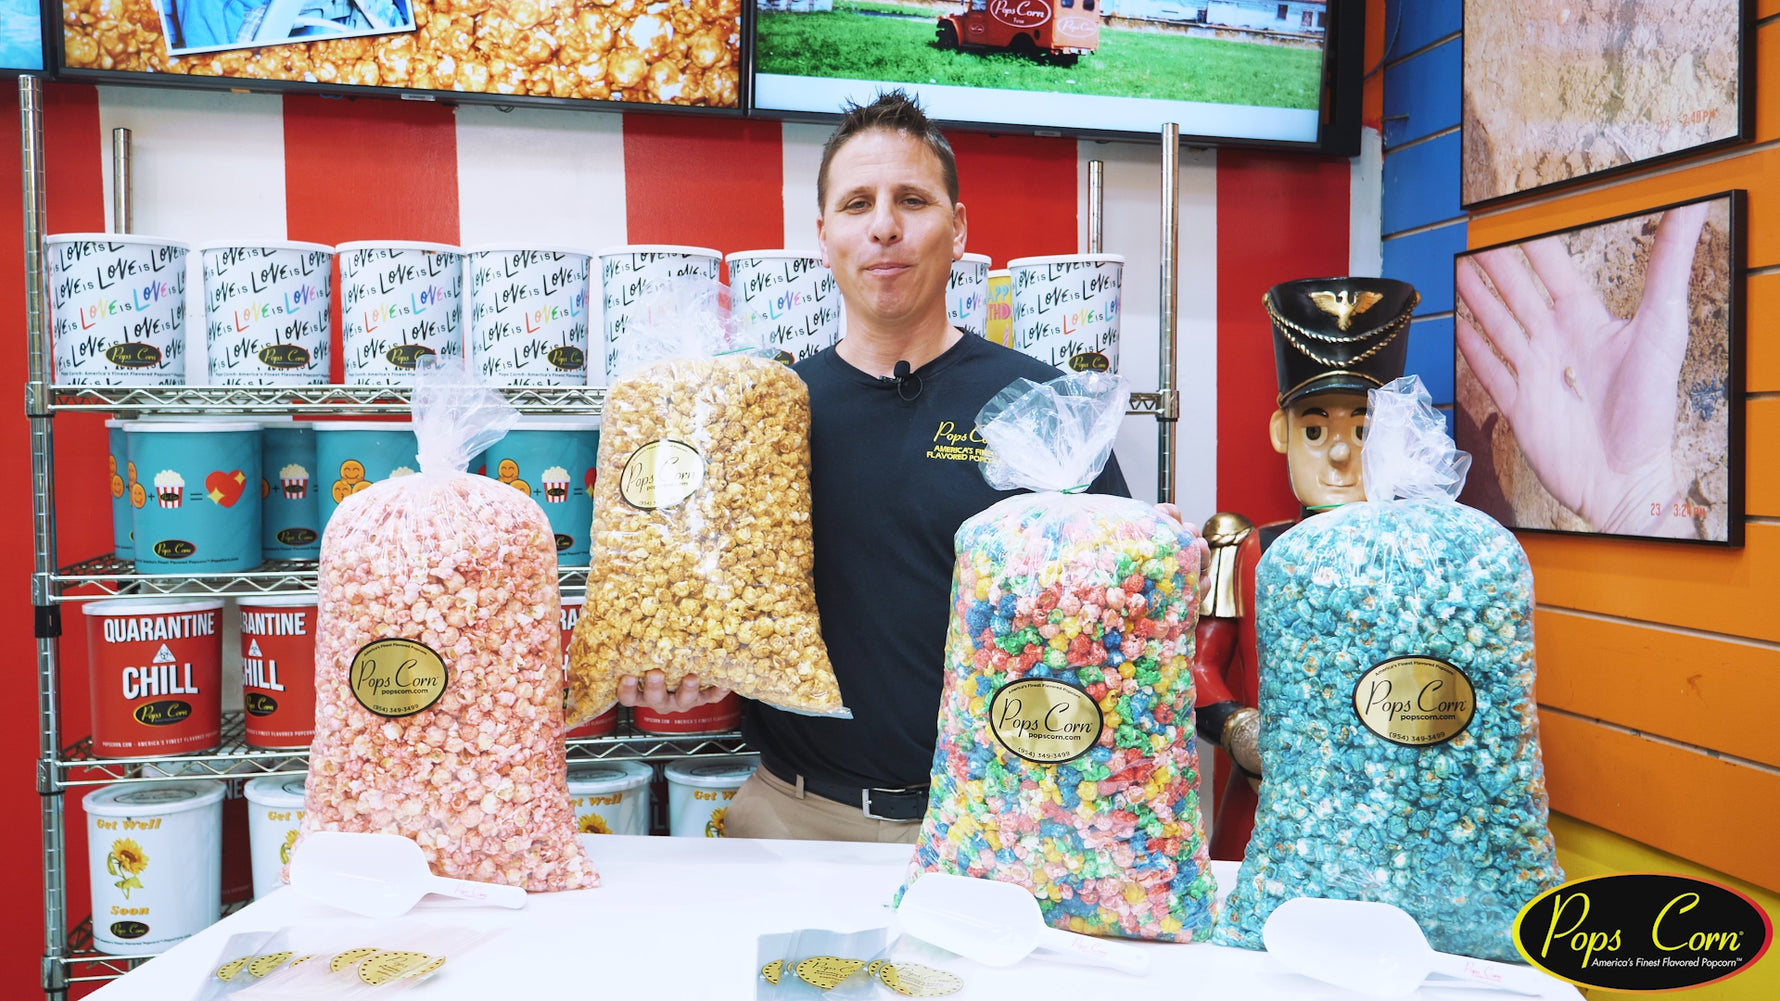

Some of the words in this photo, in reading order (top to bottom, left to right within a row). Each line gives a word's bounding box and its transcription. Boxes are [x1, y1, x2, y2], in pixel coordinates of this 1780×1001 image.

[994, 0, 1016, 17] Pops
[1016, 0, 1045, 18] Corn
[60, 241, 91, 272] LOVE
[216, 247, 246, 276] LOVE
[348, 249, 374, 278] LOVE
[505, 250, 538, 278] LOVE
[55, 277, 81, 309] LOVE
[97, 258, 137, 290] LOVE
[151, 245, 179, 272] LOVE
[210, 281, 235, 312] LOVE
[251, 262, 288, 293] LOVE
[301, 251, 326, 277] LOVE
[344, 283, 365, 314] LOVE
[379, 264, 414, 294] LOVE
[428, 252, 455, 277] LOVE
[495, 282, 527, 313] LOVE
[543, 266, 573, 296] LOVE
[744, 272, 772, 302] LOVE
[785, 258, 815, 283] LOVE
[80, 298, 117, 330] LOVE
[133, 280, 168, 312] LOVE
[234, 301, 270, 332] LOVE
[284, 283, 316, 314] LOVE
[364, 302, 397, 333] LOVE
[411, 284, 444, 315] LOVE
[769, 290, 801, 320] LOVE
[1038, 286, 1069, 315] LOVE
[1083, 273, 1110, 300] LOVE
[483, 321, 510, 351] LOVE
[525, 303, 559, 334] LOVE
[806, 307, 831, 336] LOVE
[1023, 321, 1050, 349] LOVE
[1063, 307, 1095, 335] LOVE
[71, 335, 106, 367] LOVE
[112, 346, 131, 363] Pops
[226, 337, 258, 368] LOVE
[265, 348, 282, 364] Pops
[357, 338, 386, 368] LOVE
[392, 348, 409, 364] Pops
[514, 338, 548, 369] LOVE
[933, 421, 967, 446] Pops
[969, 424, 988, 444] Co
[926, 451, 968, 461] FLAVORED
[934, 445, 974, 455] AMERICA'S
[626, 462, 654, 493] Pops
[1650, 503, 1661, 516] 23
[1693, 506, 1707, 518] PM
[104, 612, 215, 643] QUARANTINE
[241, 611, 307, 636] RANTINE
[122, 663, 199, 700] CHILL
[357, 659, 390, 696] Pops
[395, 659, 437, 687] Corn
[1375, 663, 1397, 676] America's
[1008, 684, 1027, 694] America's
[1365, 680, 1411, 721] Pops
[1417, 680, 1465, 712] Corn
[141, 704, 162, 723] Pops
[167, 701, 188, 717] Corn
[373, 704, 388, 713] (954)
[389, 704, 419, 712] 349-3499
[999, 698, 1038, 737] Pops
[1044, 702, 1091, 733] Corn
[1028, 732, 1081, 741] popscorn.com
[1389, 732, 1409, 741] (954)
[1411, 732, 1445, 741] 349-3499
[1018, 747, 1035, 758] (954)
[1038, 751, 1070, 759] 349-3499
[588, 793, 623, 806] Well
[693, 790, 717, 801] Get
[96, 818, 118, 830] Get
[122, 818, 162, 830] Well
[268, 811, 290, 822] Get
[110, 905, 150, 916] Soon
